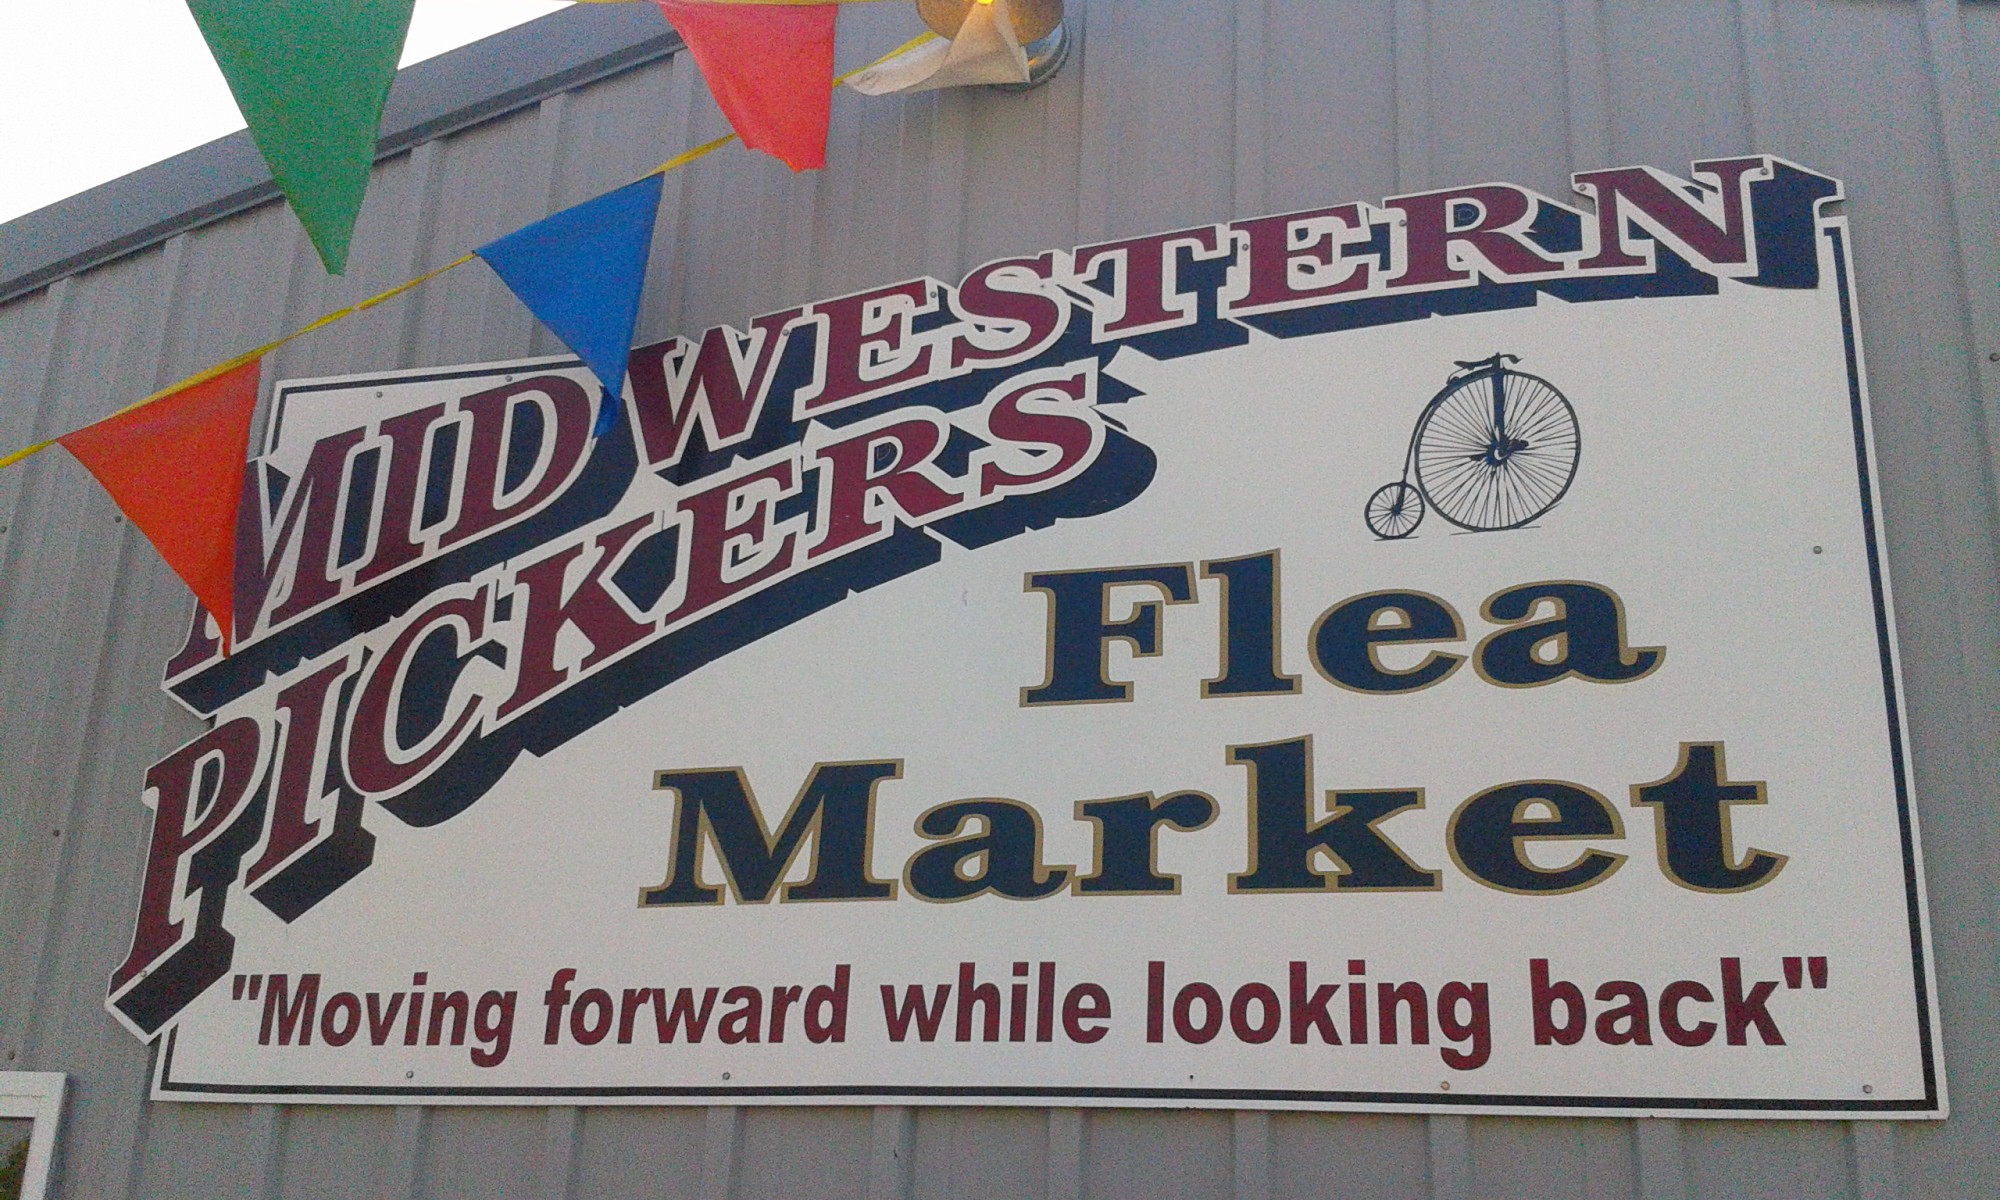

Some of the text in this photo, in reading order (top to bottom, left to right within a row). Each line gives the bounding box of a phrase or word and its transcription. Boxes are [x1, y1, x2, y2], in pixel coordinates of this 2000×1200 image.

[163, 156, 1785, 684] MIDWESTERN
[108, 372, 1096, 1000] PICKERS
[1019, 548, 1667, 707] Flea
[637, 734, 1789, 908] Market
[231, 956, 1829, 1072] "Moving forward while looking back"
